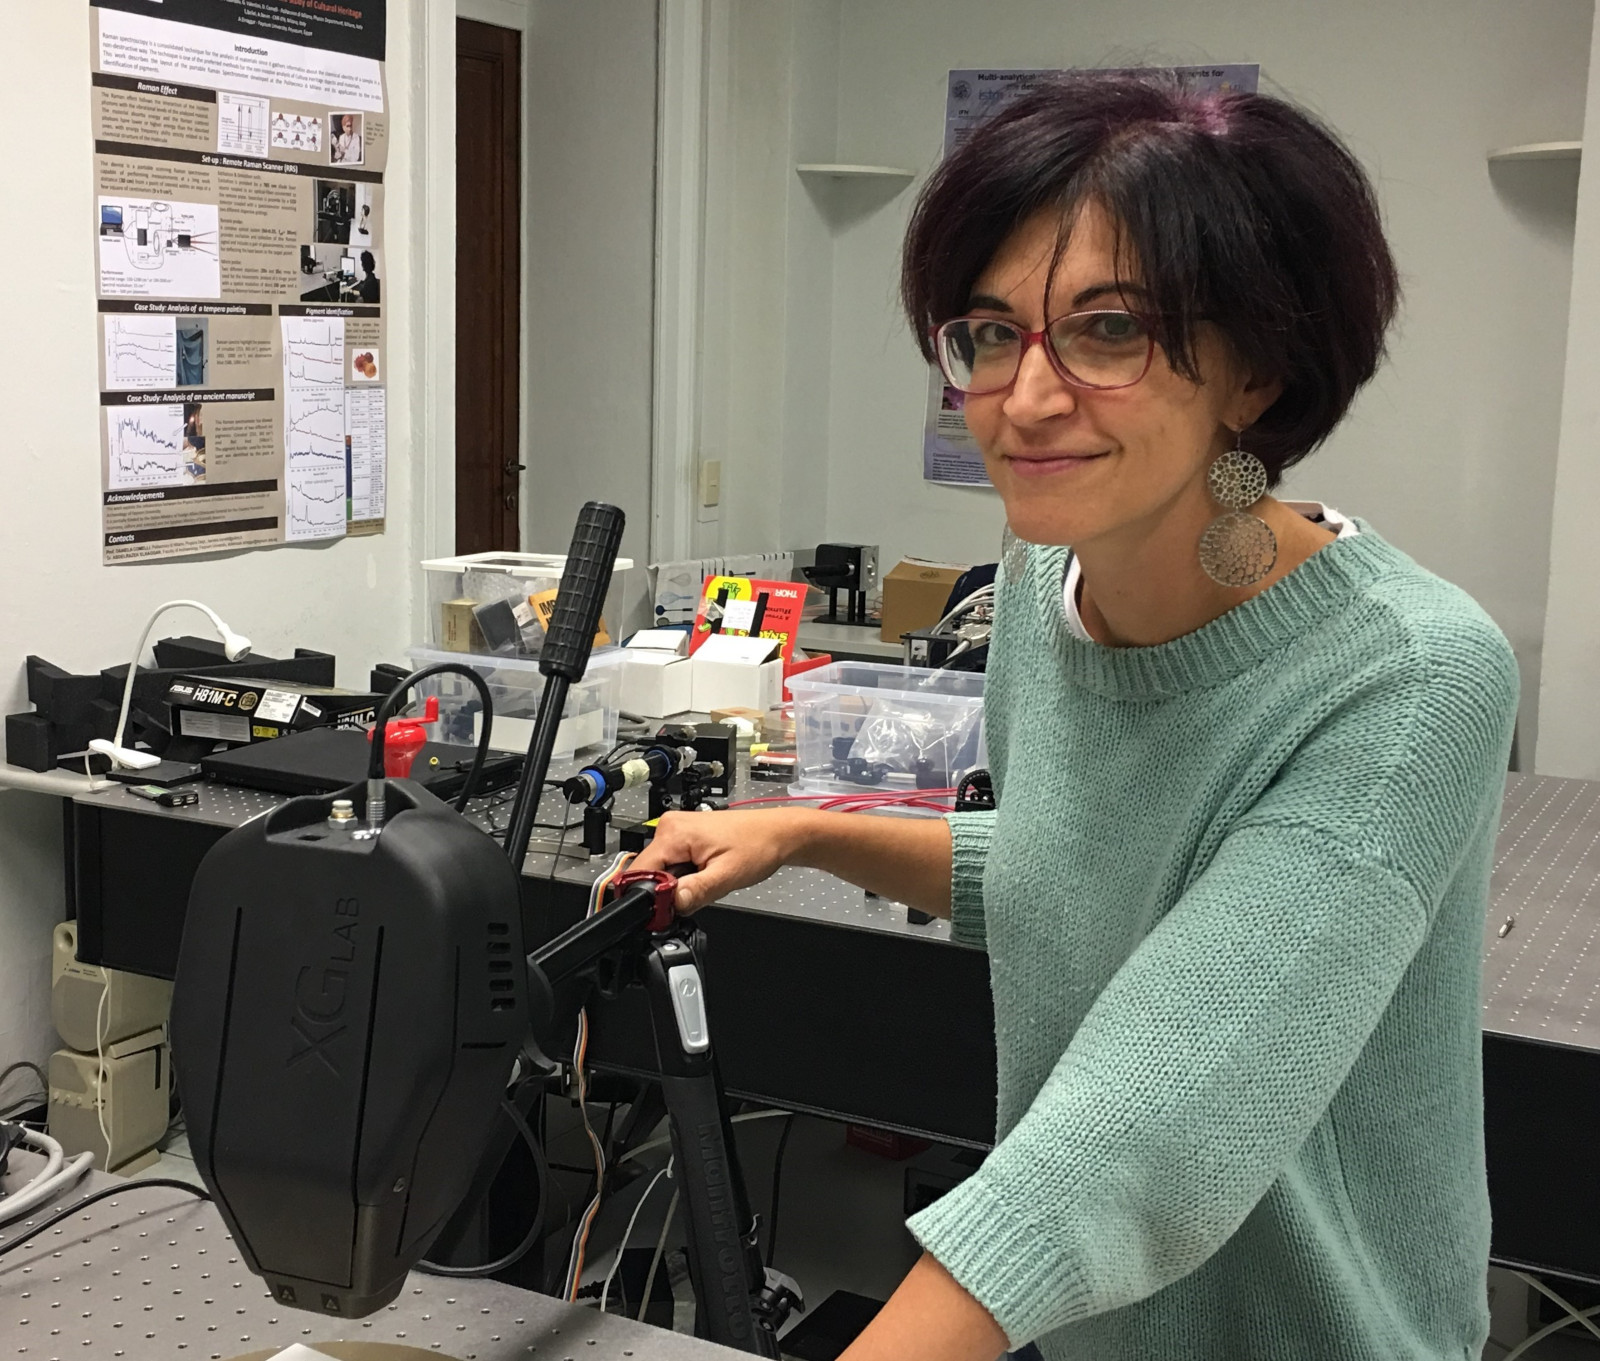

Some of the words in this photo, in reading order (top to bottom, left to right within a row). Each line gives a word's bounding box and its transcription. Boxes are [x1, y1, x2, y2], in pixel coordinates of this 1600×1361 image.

[313, 1, 337, 13] Cultural
[337, 6, 362, 19] Heritage
[234, 44, 268, 56] Introduction
[1211, 69, 1225, 77] for
[137, 82, 160, 93] Raman
[160, 85, 178, 95] Effect
[201, 154, 219, 165] Set-up
[222, 157, 242, 168] Remote
[243, 159, 262, 169] Raman
[262, 161, 284, 171] Scanner
[284, 164, 298, 174] (RRS)
[134, 303, 148, 311] Case
[149, 303, 166, 313] Study:
[167, 304, 190, 313] Analysis
[190, 304, 198, 313] of
[203, 305, 226, 315] tempera
[226, 305, 246, 315] painting
[305, 307, 326, 316] Pigment
[127, 394, 142, 403] Case
[142, 393, 162, 403] Study:
[162, 392, 186, 402] Analysis
[186, 392, 194, 402] of
[203, 392, 225, 401] ancient
[225, 391, 255, 401] manuscript
[107, 491, 165, 502] Acknowledgements
[108, 533, 135, 544] Contacts
[738, 630, 788, 641] SNAS
[169, 684, 194, 695] ASUS
[193, 687, 238, 707] H81M-C
